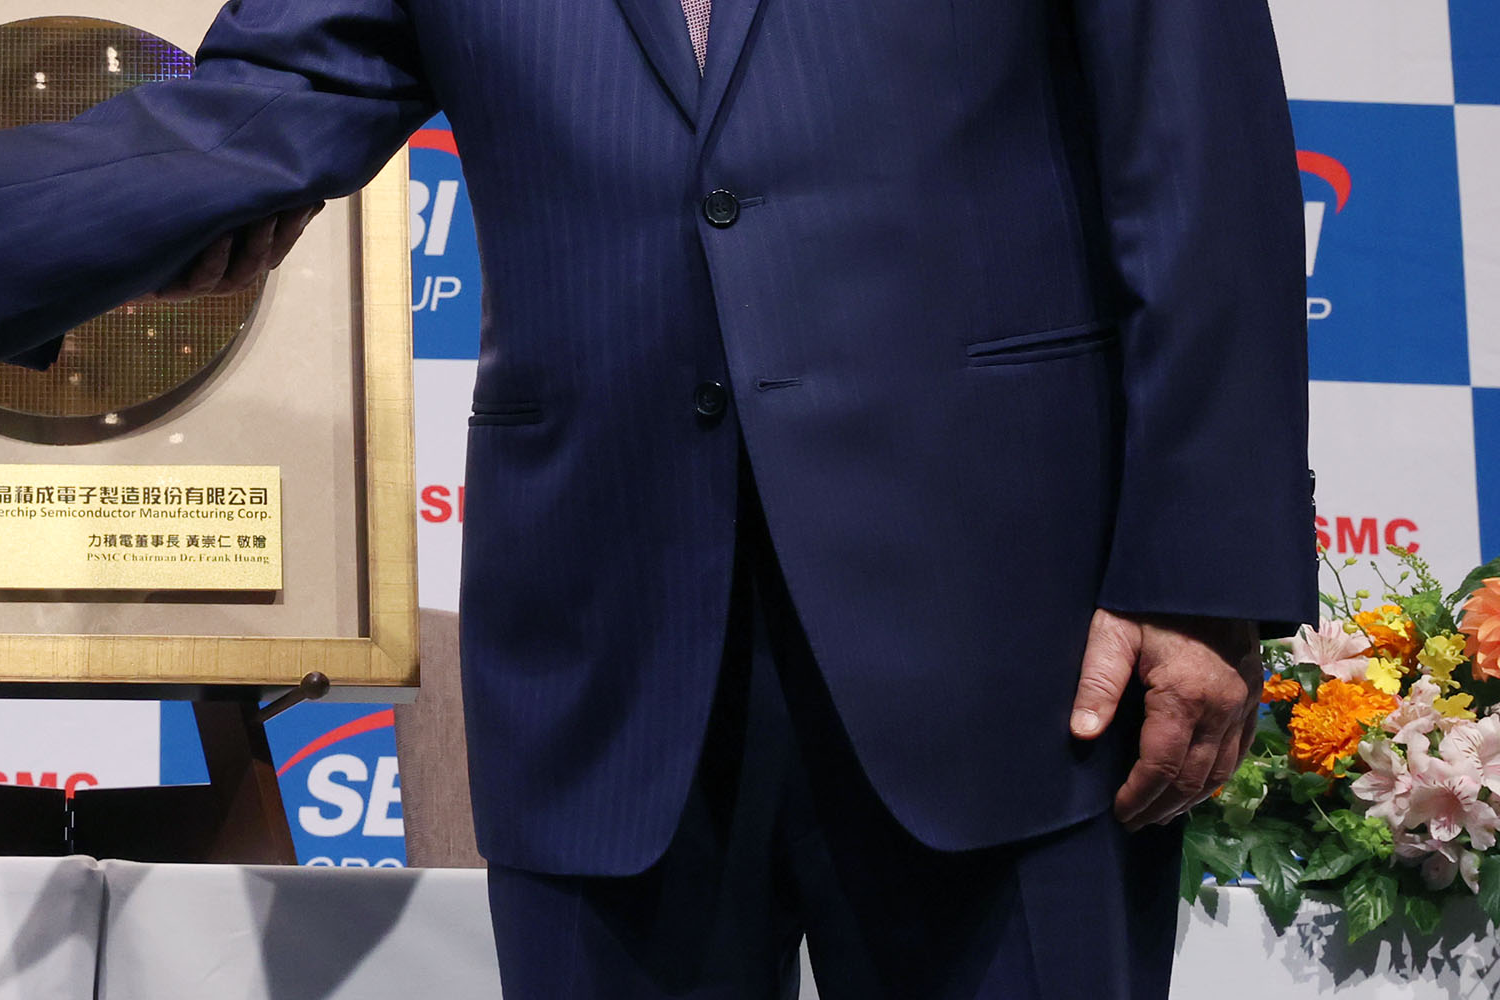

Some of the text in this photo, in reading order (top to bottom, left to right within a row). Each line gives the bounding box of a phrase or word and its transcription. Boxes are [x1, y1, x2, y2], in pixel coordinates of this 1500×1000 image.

[40, 507, 136, 518] Semiconductor
[139, 508, 235, 520] Manufacturing
[237, 508, 272, 521] Corp.
[88, 534, 180, 548] 力積電董事長
[186, 534, 231, 549] 黃崇仁
[87, 552, 270, 564] PSMC Chairman Dr. Frank Huang
[298, 753, 405, 837] SB
